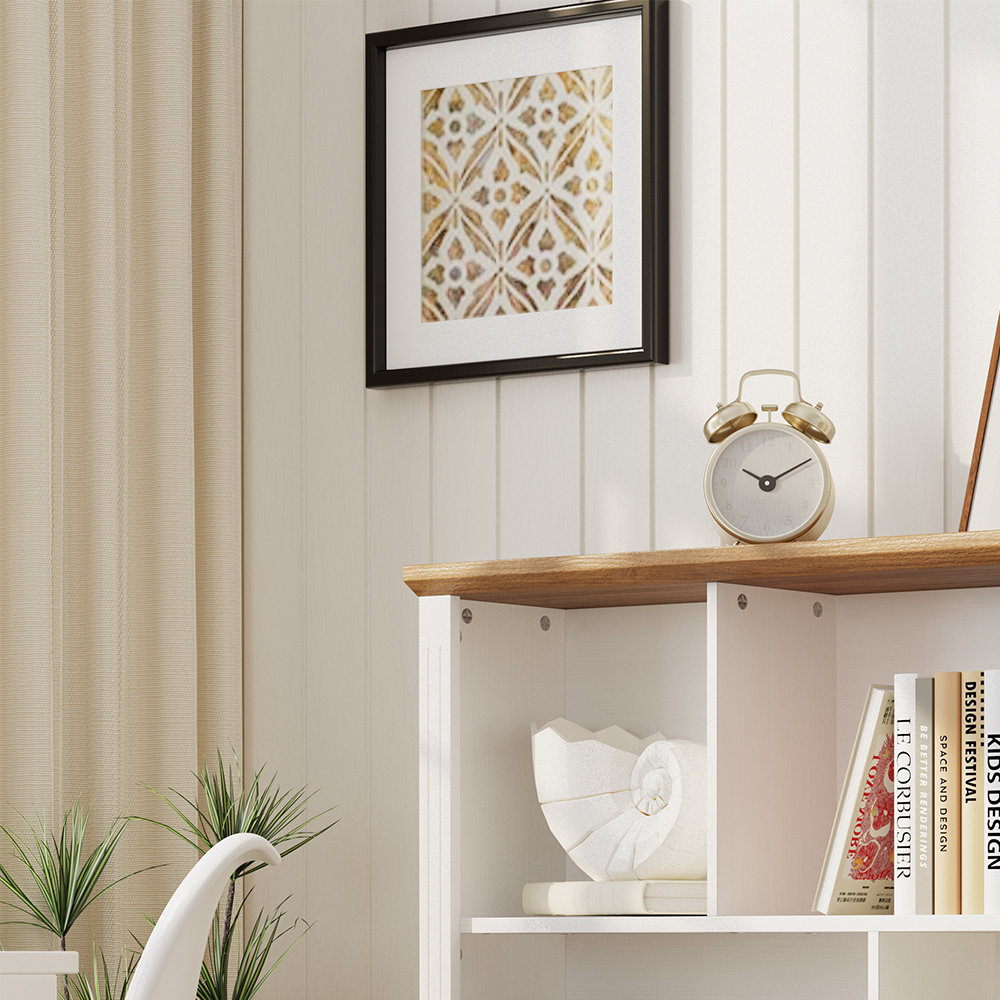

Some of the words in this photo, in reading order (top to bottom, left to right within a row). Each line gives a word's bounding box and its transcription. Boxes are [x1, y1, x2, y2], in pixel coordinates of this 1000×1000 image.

[965, 681, 977, 735] DESIGN
[896, 718, 912, 745] LE
[920, 725, 928, 739] BE
[939, 735, 948, 773] SPACE
[920, 740, 928, 788] BETTER
[965, 741, 977, 804] FESTIVAL
[939, 778, 948, 803] AND
[896, 751, 912, 879] CORBUSIER
[920, 791, 928, 869] RENDERINGS
[939, 808, 948, 853] DESIGN
